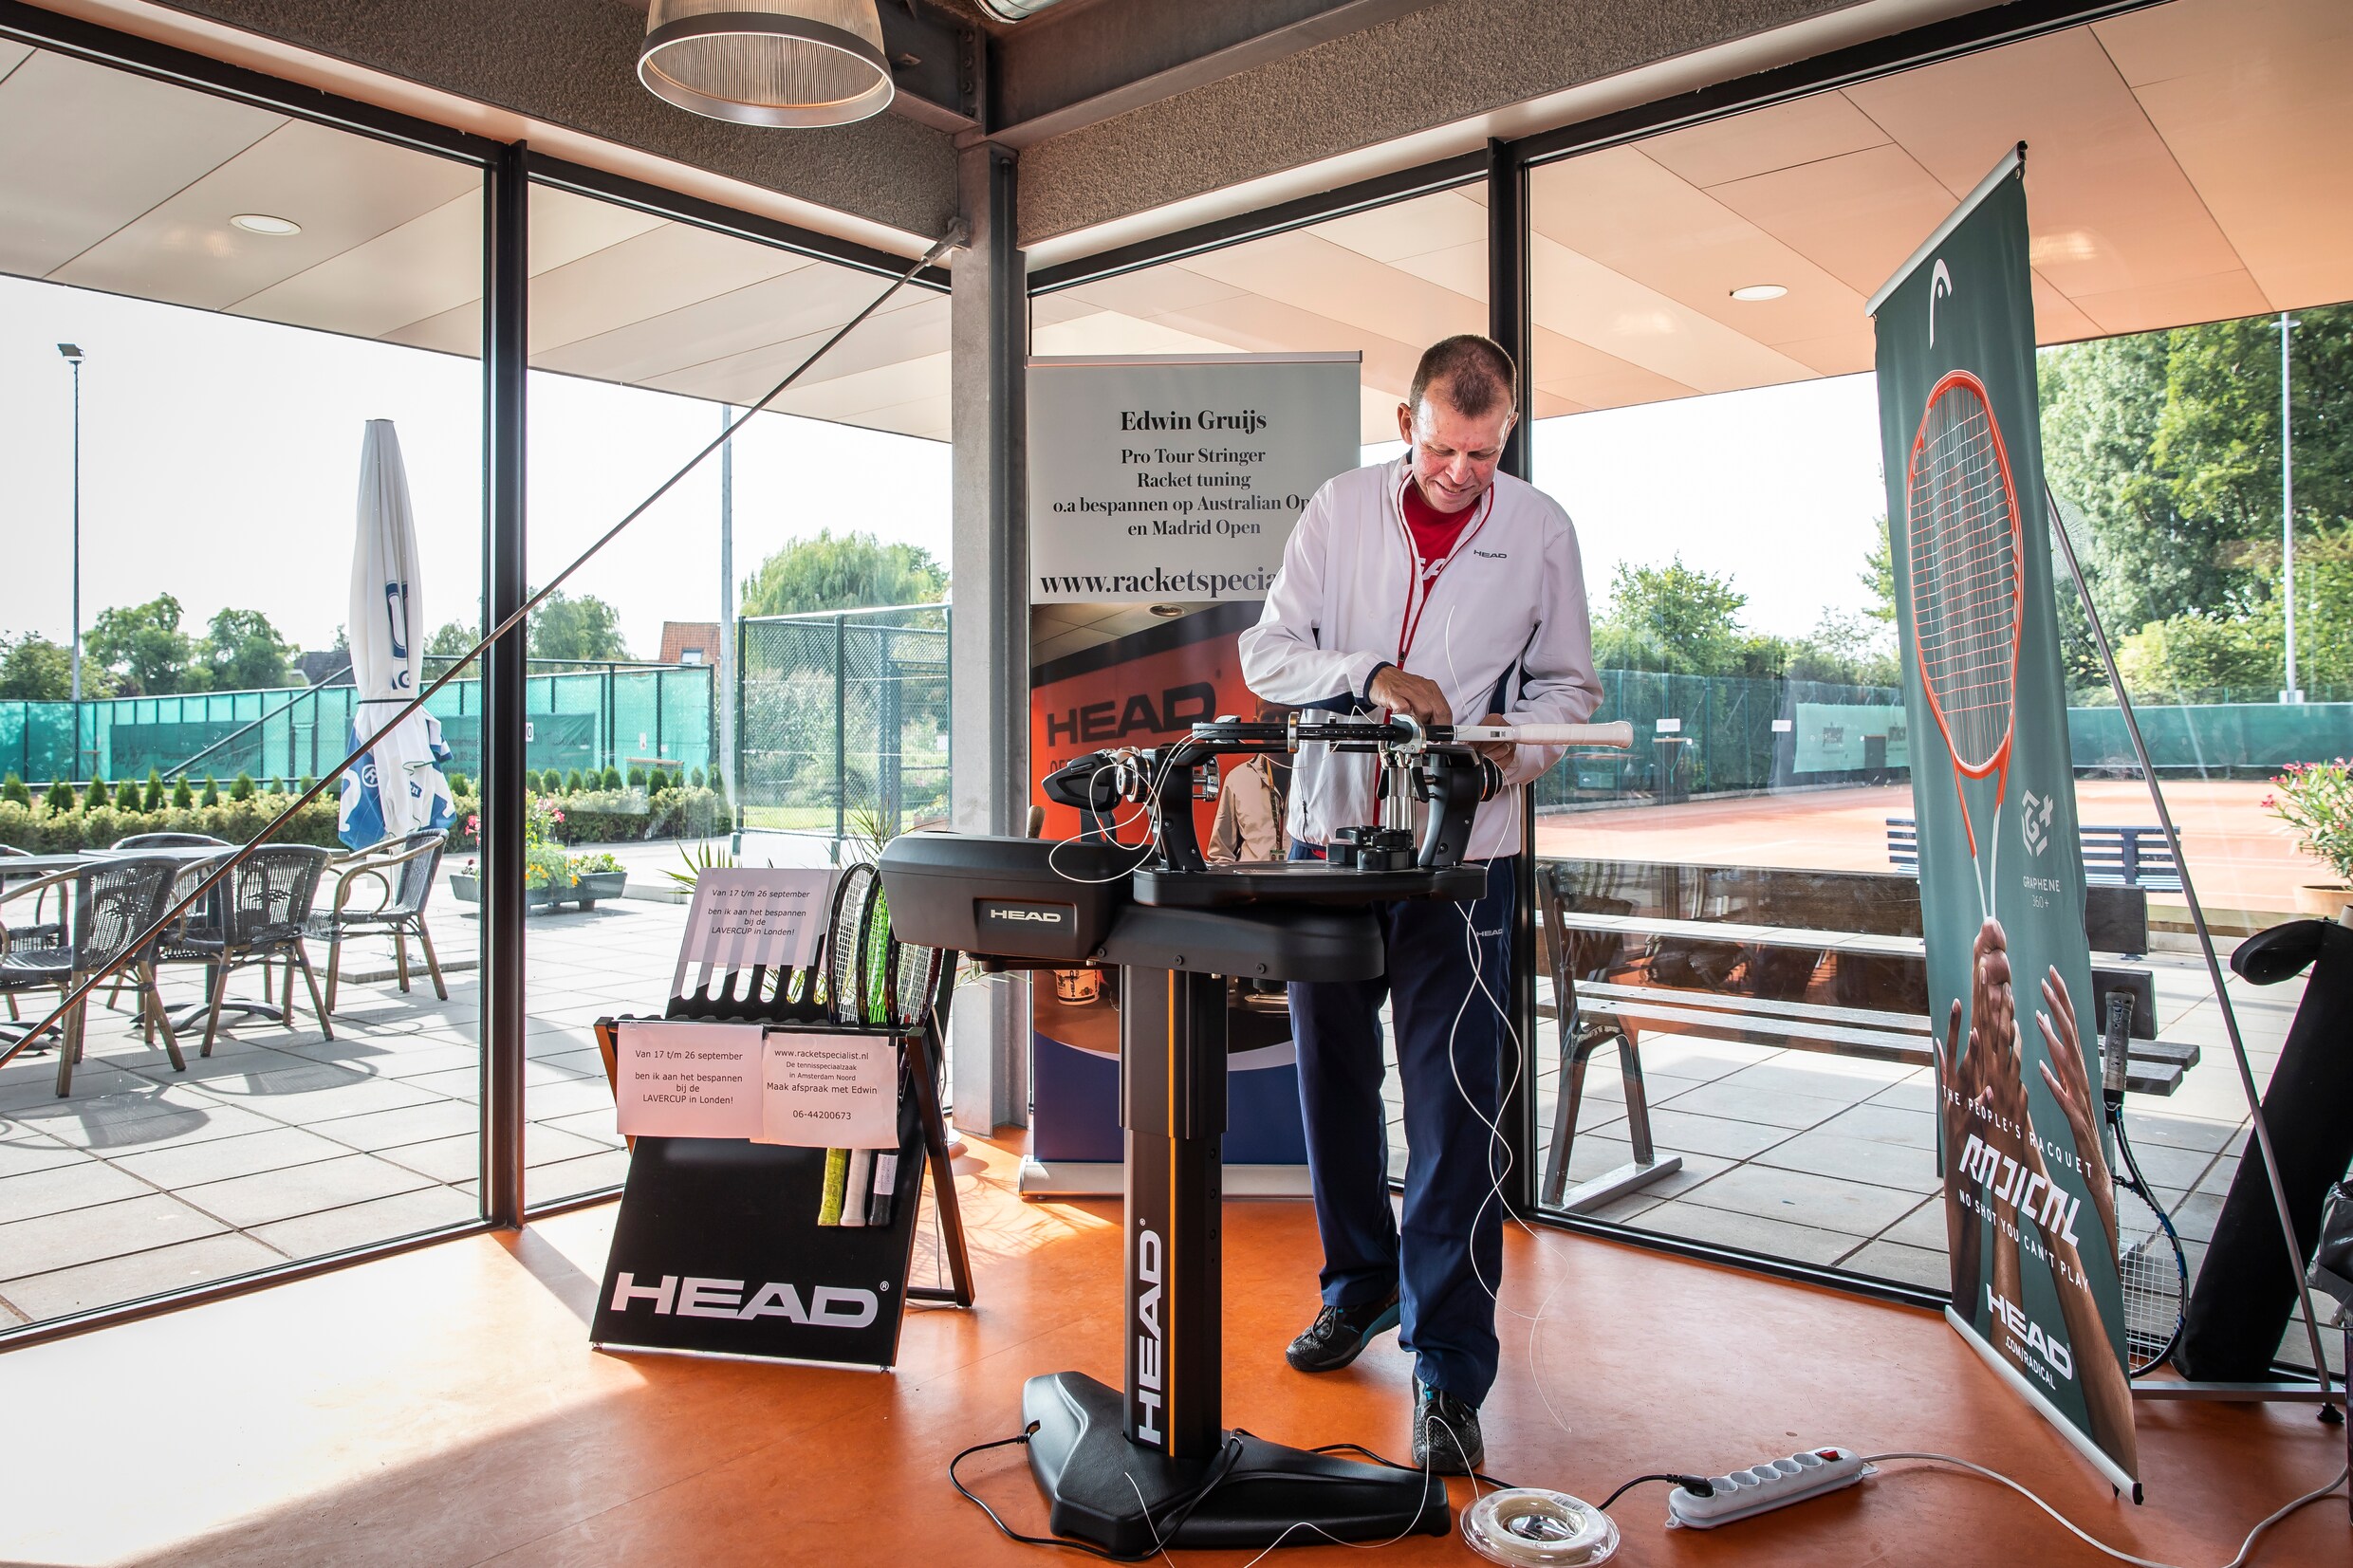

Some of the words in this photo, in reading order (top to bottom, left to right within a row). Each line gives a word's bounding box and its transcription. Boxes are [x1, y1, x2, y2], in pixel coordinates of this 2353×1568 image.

[1120, 410, 1192, 432] Edwin
[1197, 409, 1268, 434] Gruijs
[1121, 448, 1151, 464] Pro
[1154, 448, 1195, 464] Tour
[1197, 447, 1267, 466] Stringer
[1137, 472, 1194, 488] Racket
[1196, 472, 1251, 489] tuning
[1052, 500, 1076, 513] o.a
[1080, 497, 1168, 516] bespannen
[1172, 499, 1194, 515] op
[1197, 494, 1282, 512] Australian
[1127, 524, 1148, 537] en
[1152, 520, 1212, 536] Madrid
[1215, 519, 1262, 538] Open
[1473, 549, 1508, 559] HEAD
[1047, 682, 1216, 747] HEAD
[2022, 876, 2061, 893] GRAPHENE
[765, 909, 806, 917] bespannen
[990, 909, 1062, 923] HEAD
[744, 918, 754, 927] bij
[1476, 929, 1503, 937] HEAD
[635, 1050, 651, 1059] Van
[655, 1050, 664, 1059] 17
[667, 1051, 682, 1060] t/m
[685, 1051, 695, 1060] 26
[698, 1052, 743, 1061] september
[774, 1050, 869, 1061] www.racketspecialist.nl
[797, 1062, 857, 1071] tennisspeciaalzaak
[653, 1072, 660, 1080] ik
[680, 1073, 695, 1081] het
[696, 1074, 743, 1083] bespannen
[797, 1072, 835, 1080] Amsterdam
[676, 1084, 687, 1094] bij
[689, 1084, 700, 1093] de
[767, 1082, 789, 1091] Maak
[791, 1083, 829, 1093] afspraak
[851, 1085, 878, 1095] Edwin
[642, 1094, 687, 1103] LAVERCUP
[699, 1096, 733, 1104] Londen!
[792, 1110, 852, 1120] 06-44200673
[1942, 1084, 1961, 1106] THE
[1968, 1098, 2021, 1139] PEOPLE'S
[2029, 1131, 2092, 1179] RACQUET
[1958, 1133, 2081, 1247] RADICAL
[1959, 1189, 1972, 1208] NO
[1975, 1200, 1997, 1227] SHOT
[2000, 1218, 2019, 1243] YOU
[2024, 1235, 2055, 1268] CAN'T
[2060, 1260, 2088, 1293] PLAY
[610, 1272, 879, 1328] HEAD
[1139, 1229, 1162, 1445] HEAD
[1986, 1282, 2072, 1380] HEAD
[2005, 1335, 2056, 1391] .COM/RADICAL
